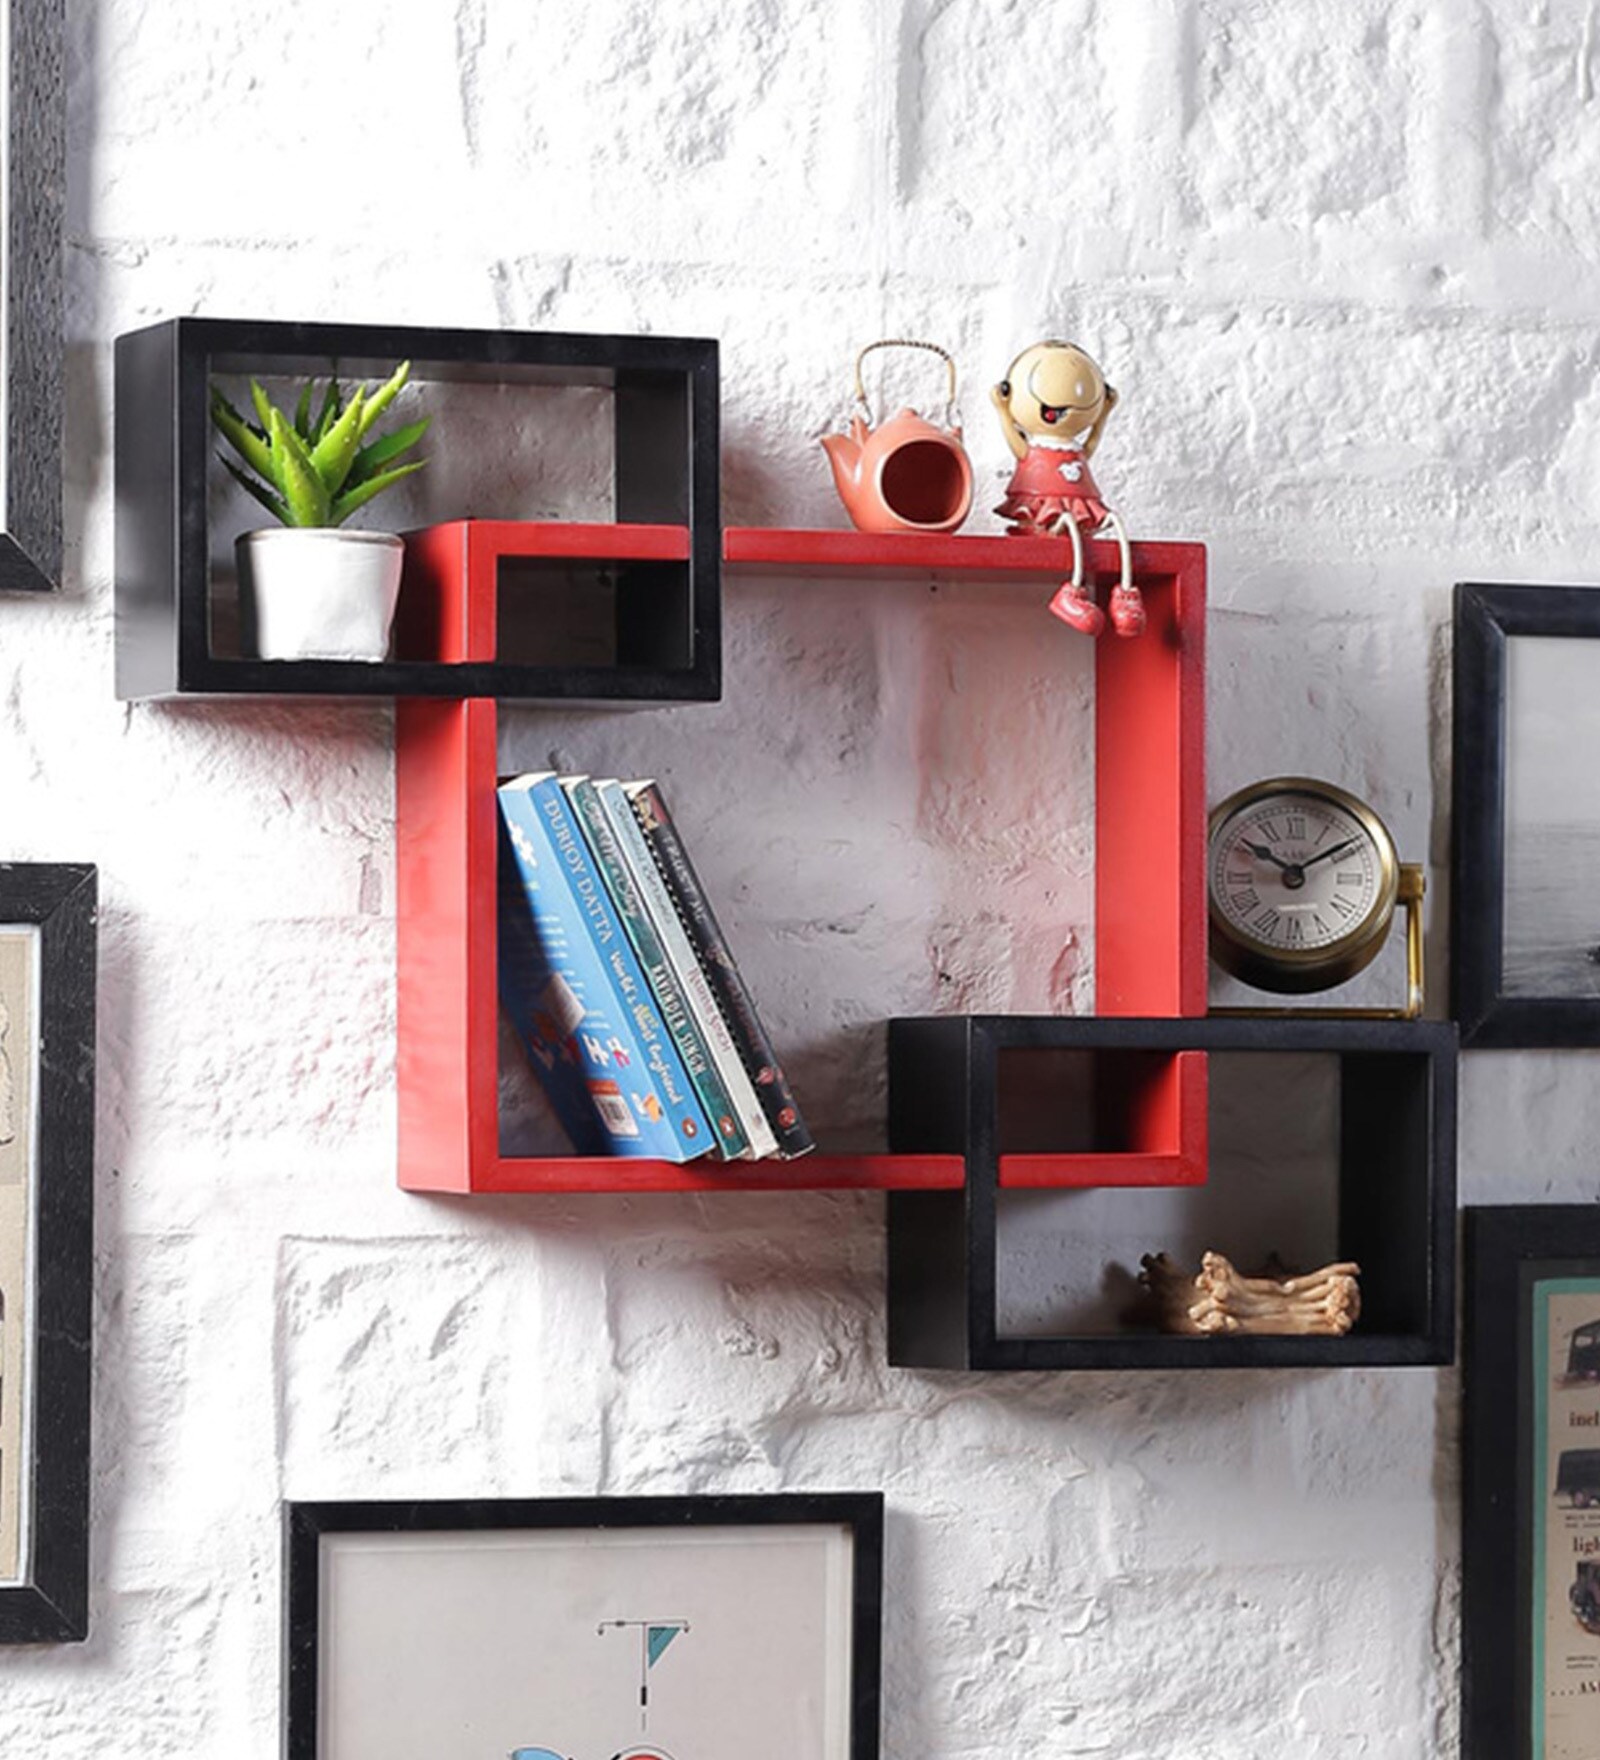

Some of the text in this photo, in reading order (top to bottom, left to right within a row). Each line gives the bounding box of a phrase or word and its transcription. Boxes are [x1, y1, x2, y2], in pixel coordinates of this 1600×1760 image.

[542, 797, 587, 875] DURJOY
[576, 877, 616, 943] DATTA
[660, 831, 698, 897] TRUST
[642, 1042, 685, 1106] Boyfriend
[677, 1032, 708, 1075] SINGH
